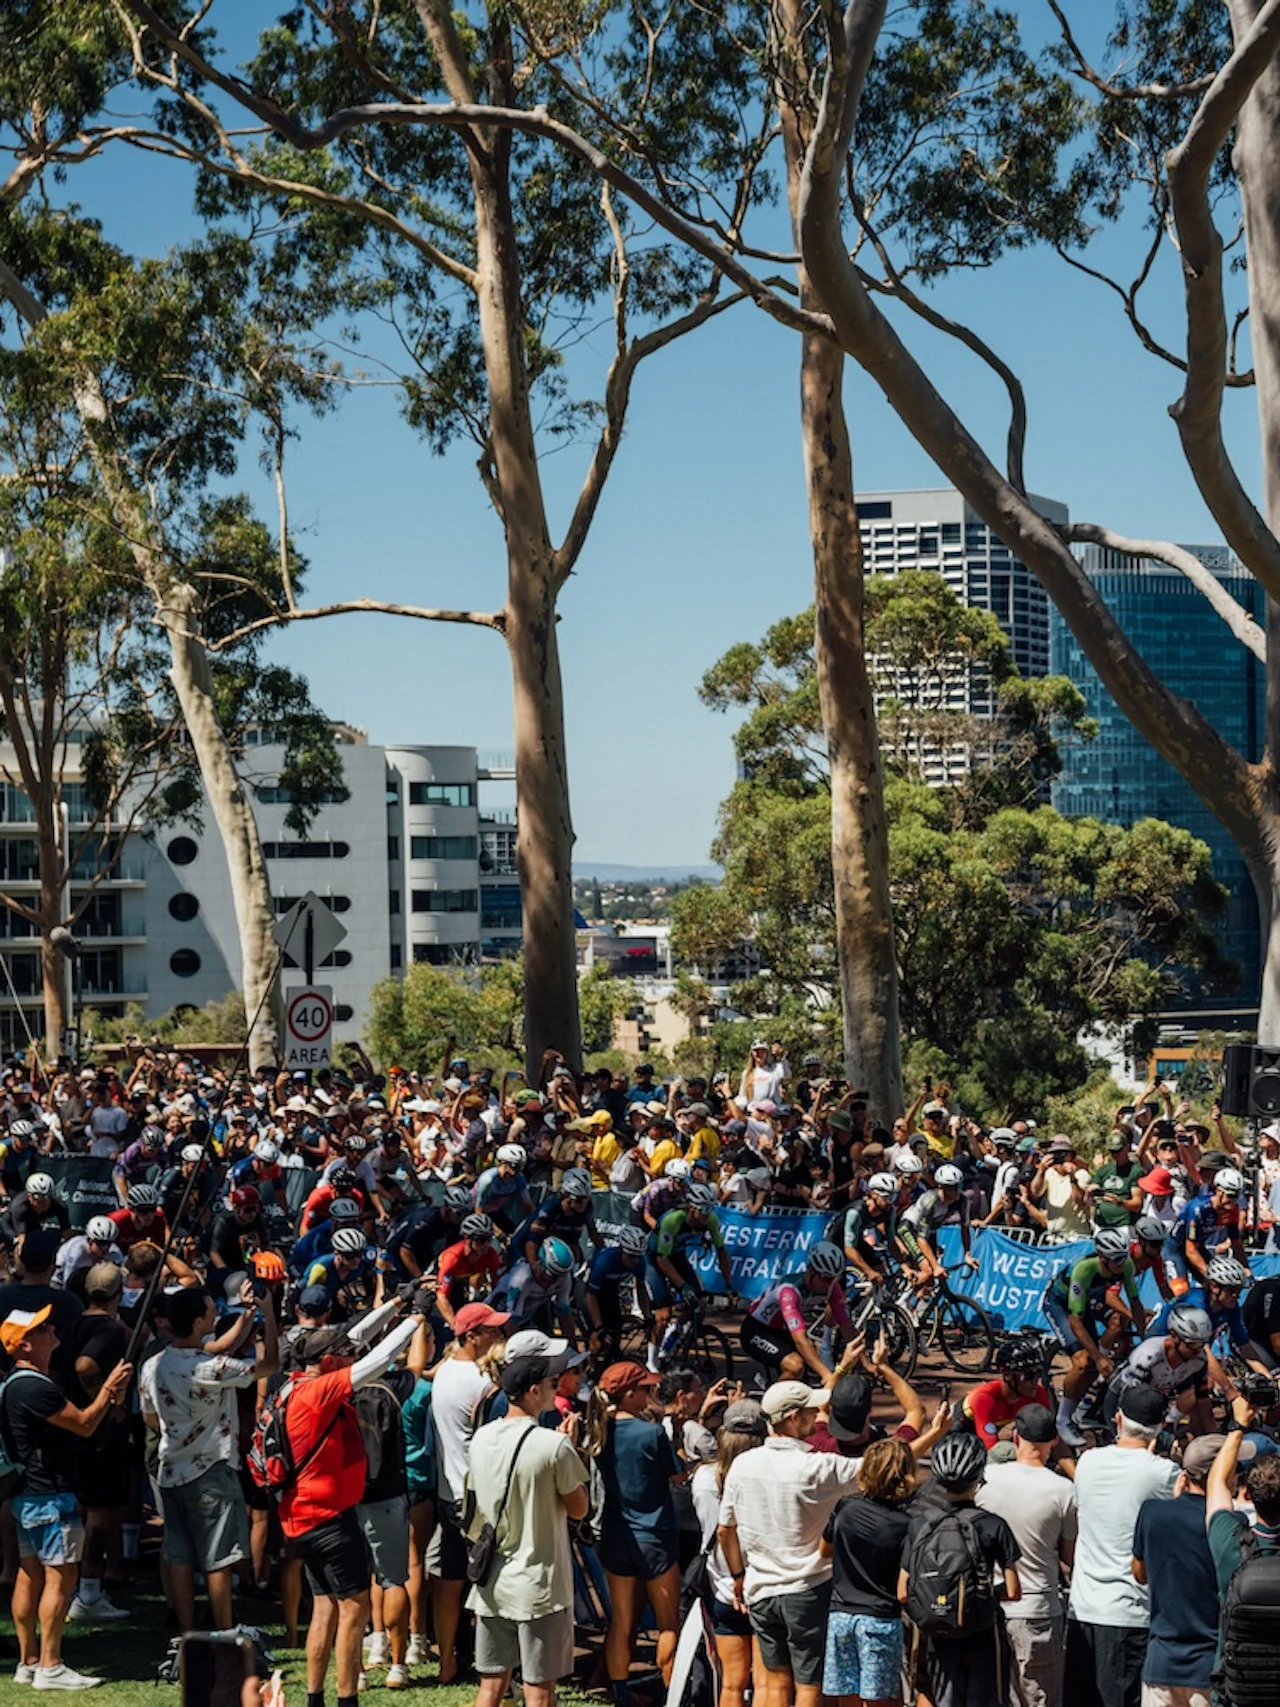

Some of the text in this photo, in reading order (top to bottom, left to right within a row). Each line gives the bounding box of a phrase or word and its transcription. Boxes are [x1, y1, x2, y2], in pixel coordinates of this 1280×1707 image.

[295, 1007, 324, 1028] 40
[289, 1048, 330, 1063] AREA
[720, 1224, 813, 1252] ESTERN
[993, 1250, 1068, 1280] WEST
